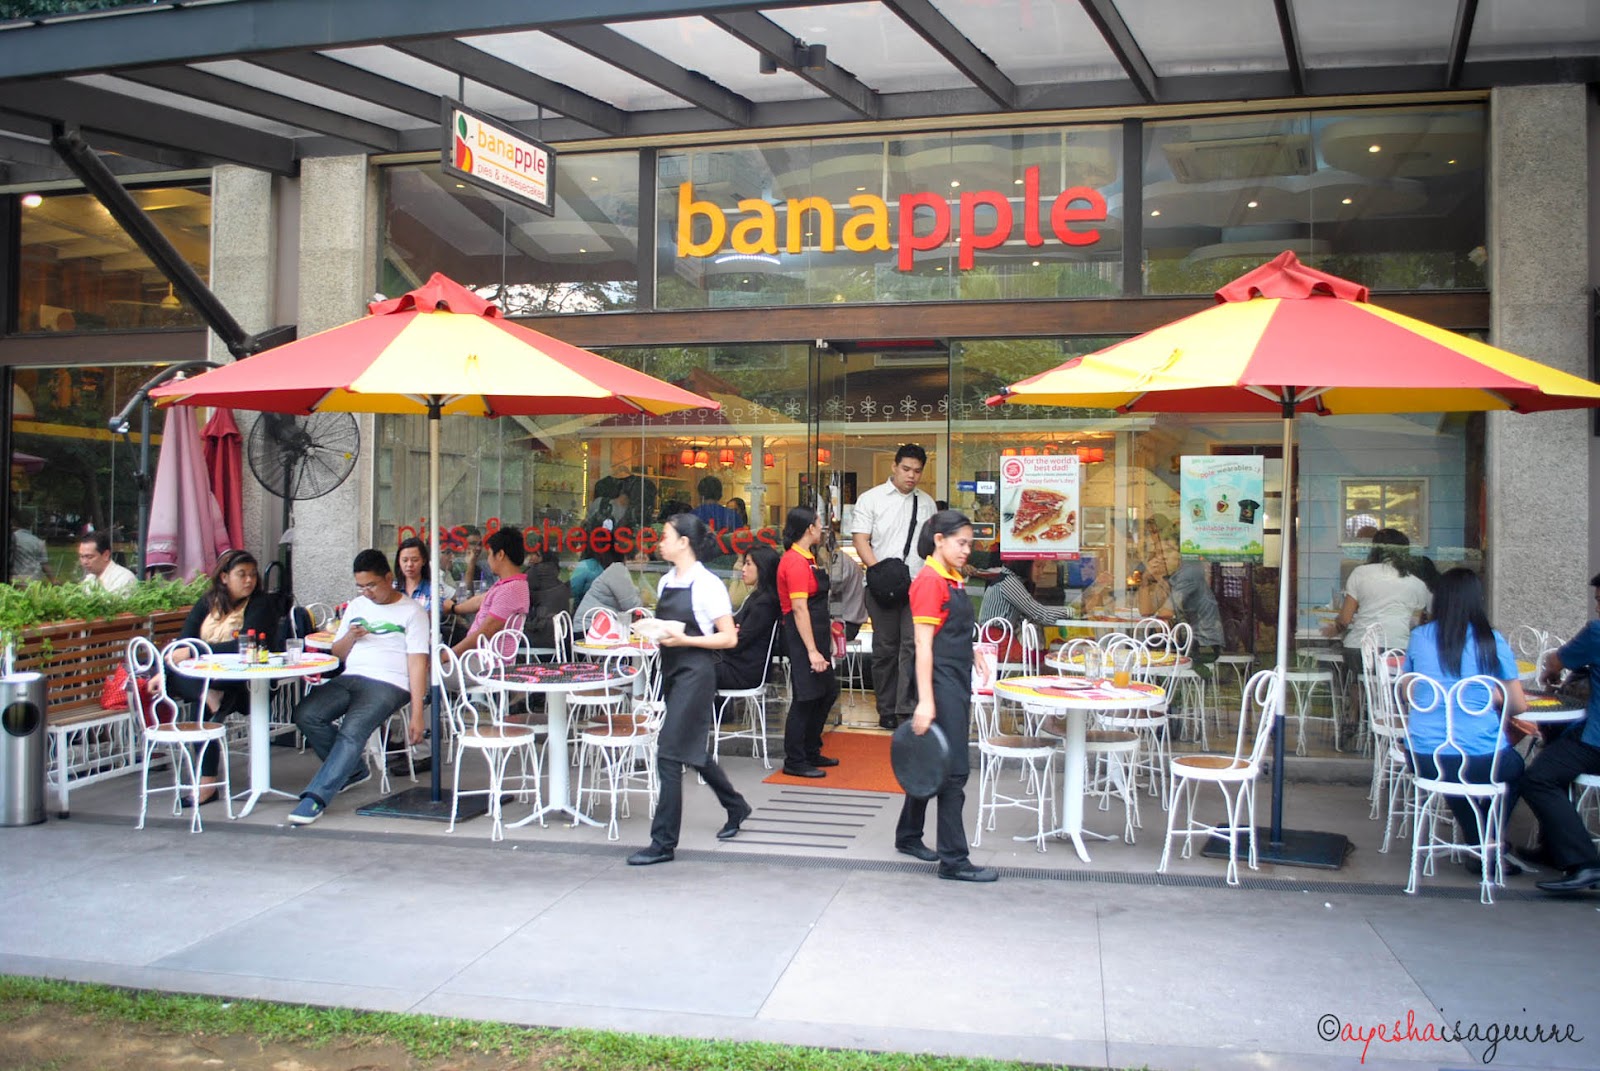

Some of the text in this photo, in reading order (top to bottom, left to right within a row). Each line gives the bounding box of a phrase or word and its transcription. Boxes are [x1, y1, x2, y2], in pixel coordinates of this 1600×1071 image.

[478, 122, 545, 174] banapple
[477, 163, 493, 178] pies
[502, 174, 545, 200] cheesecakes
[677, 165, 1107, 271] banapple
[1217, 463, 1252, 473] wearables
[522, 517, 777, 555] cheesekes
